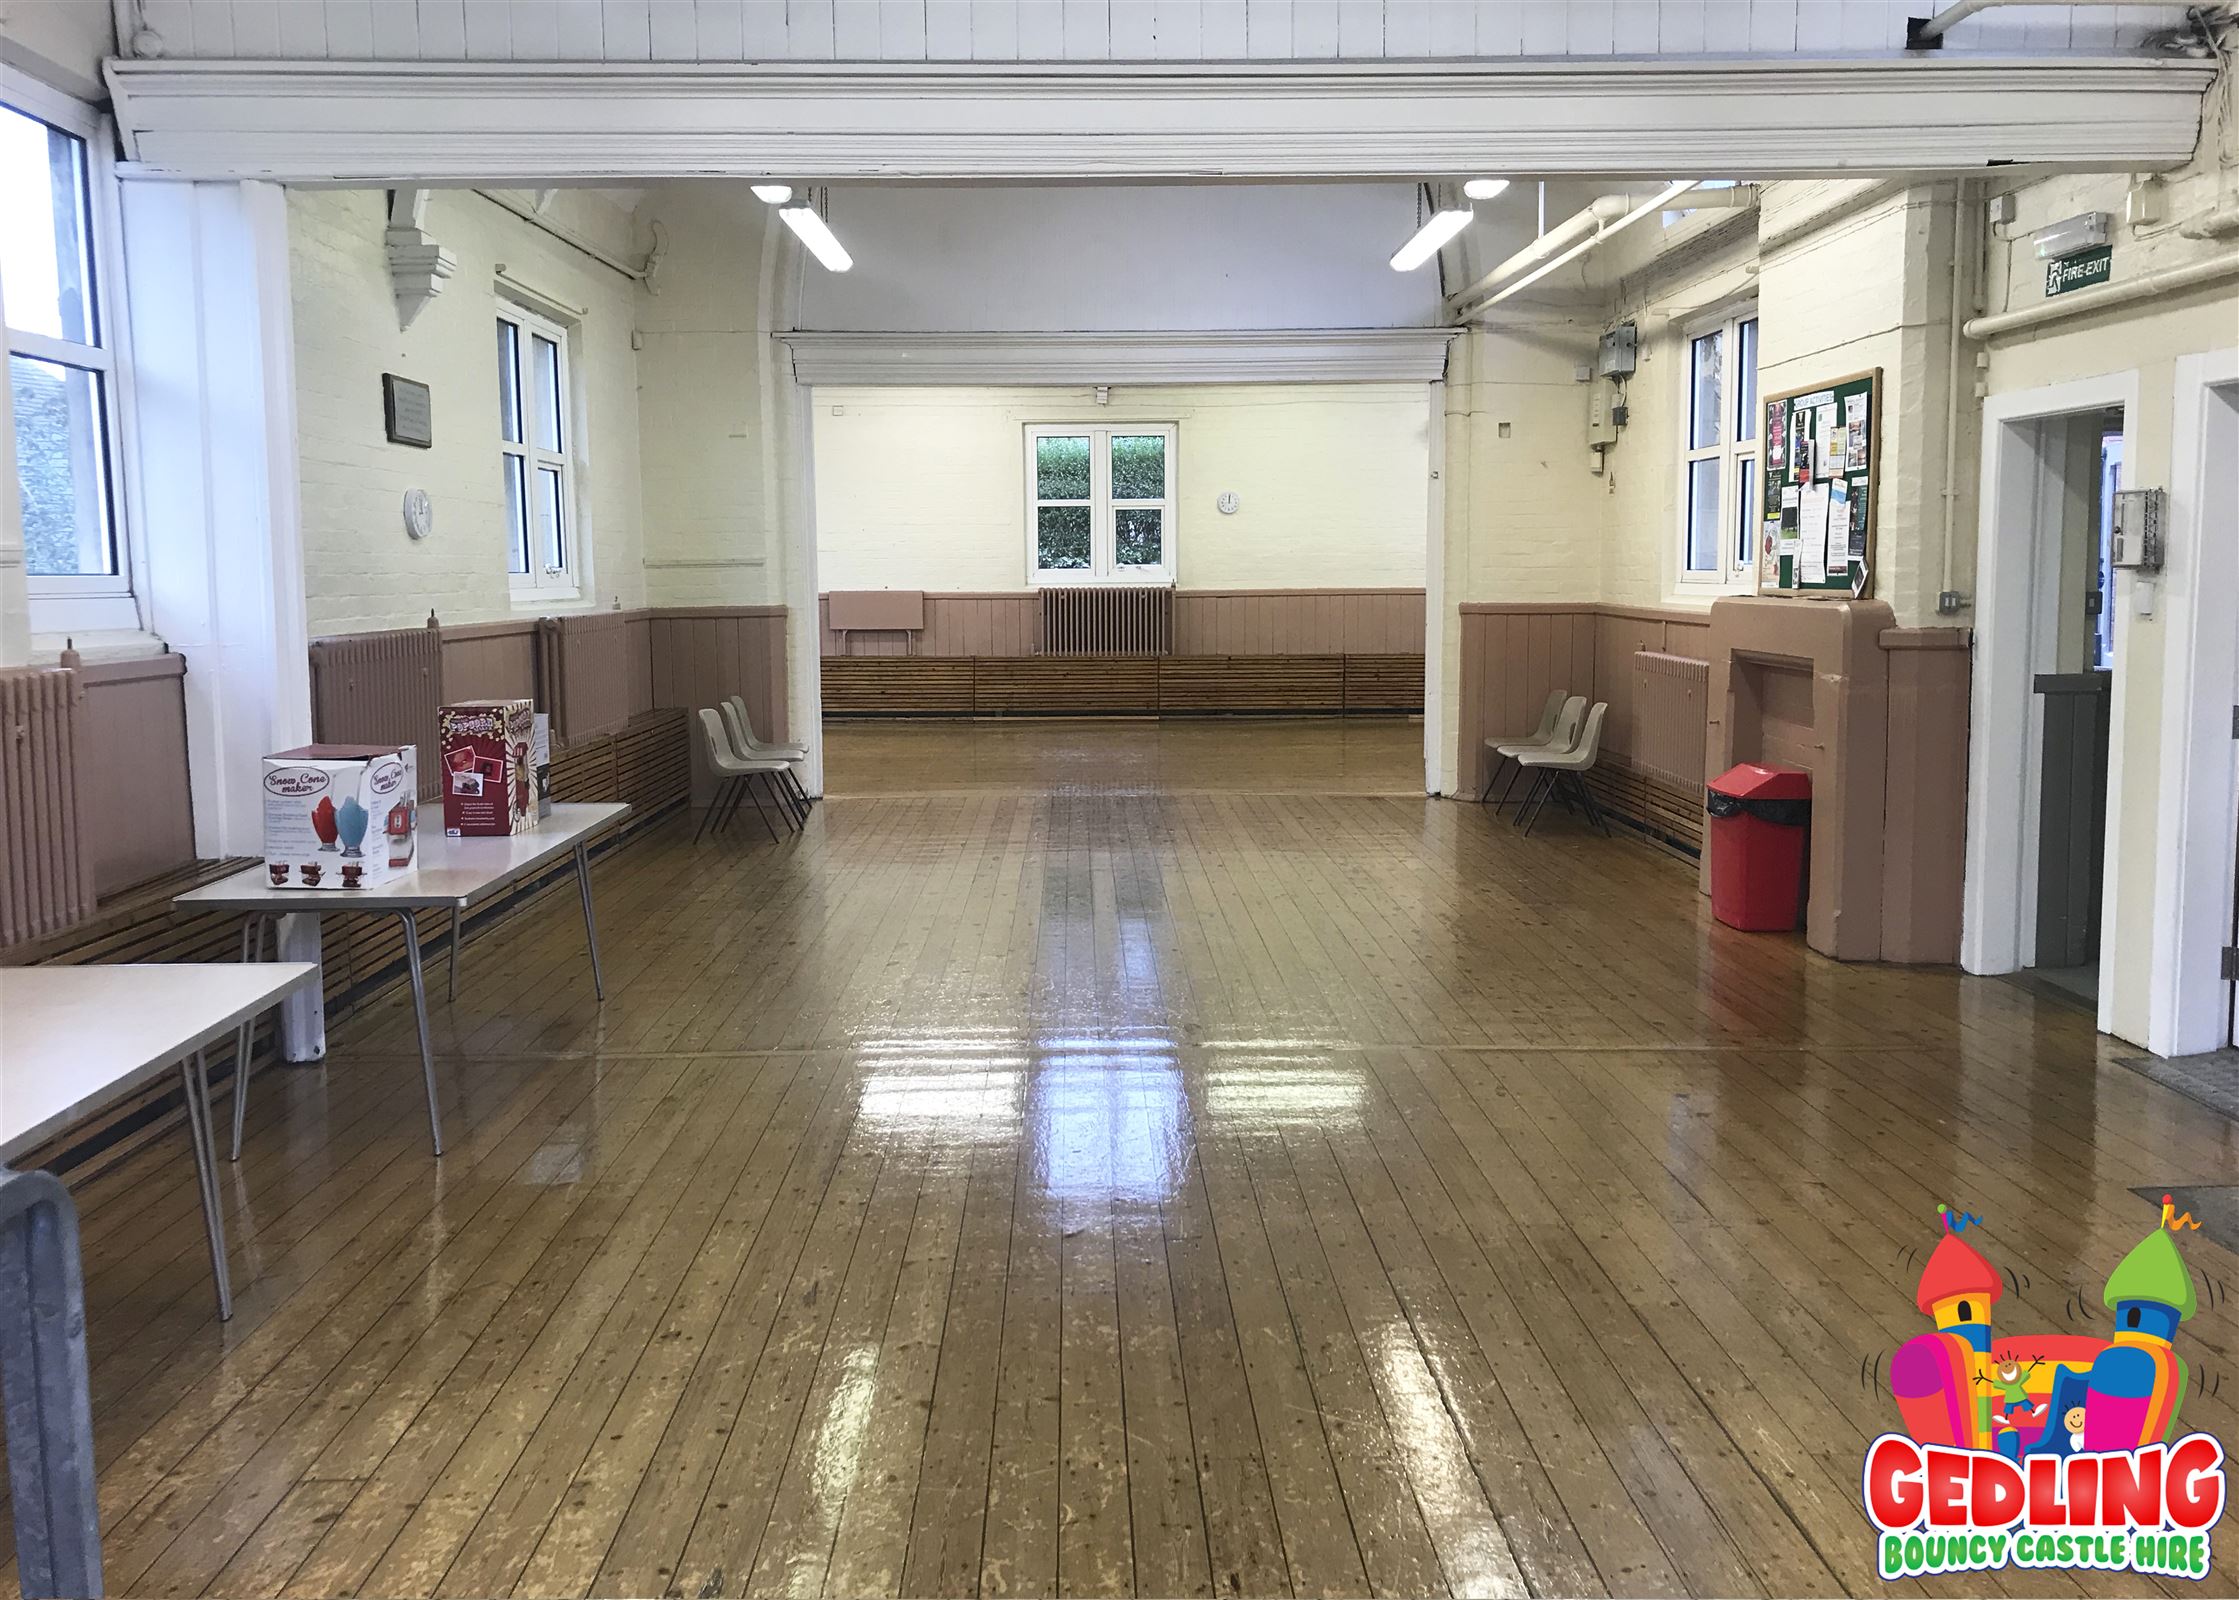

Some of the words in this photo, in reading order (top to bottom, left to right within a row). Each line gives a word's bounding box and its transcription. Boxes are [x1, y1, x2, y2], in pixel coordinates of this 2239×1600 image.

[269, 775, 297, 785] Snow
[300, 773, 326, 783] Cone
[282, 782, 312, 792] maker
